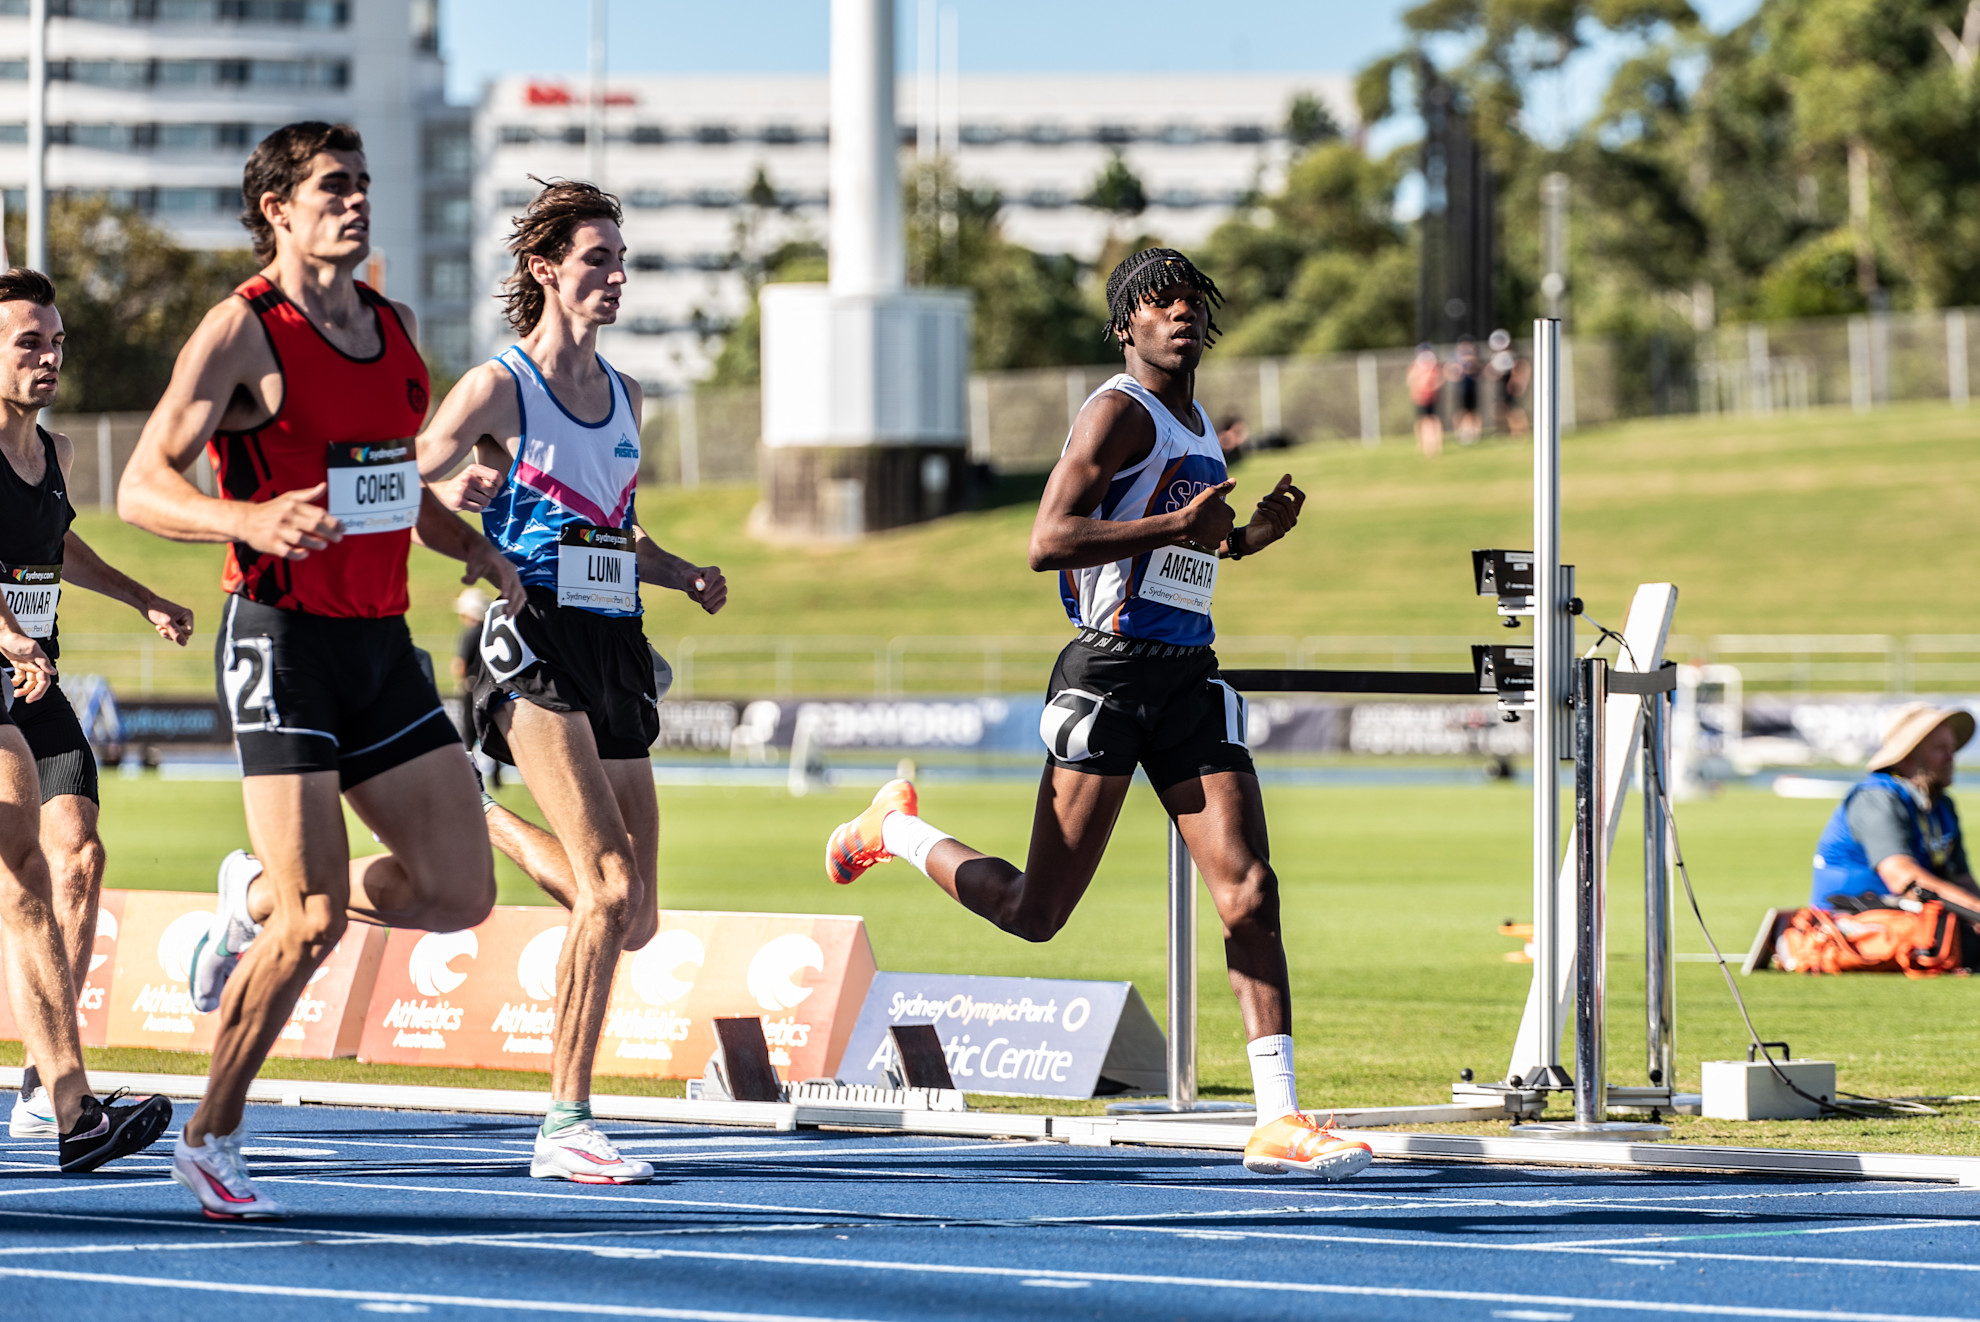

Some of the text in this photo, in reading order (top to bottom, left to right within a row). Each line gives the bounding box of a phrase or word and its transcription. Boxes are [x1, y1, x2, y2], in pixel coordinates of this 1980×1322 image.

[614, 447, 639, 459] RISING
[356, 472, 406, 505] COHEN
[595, 533, 628, 546] sydney.com
[25, 571, 55, 582] sydney.com
[588, 555, 621, 584] LUNN
[1159, 552, 1214, 589] AMEKATA
[6, 590, 51, 615] DONNAR
[485, 603, 523, 674] 5
[229, 645, 265, 723] 2
[1052, 693, 1098, 758] 7
[142, 1013, 195, 1033] Australia
[383, 998, 464, 1031] Athletics
[604, 1007, 691, 1041] Athletics
[392, 1029, 446, 1049] Australia
[762, 1015, 812, 1047] letics
[615, 1039, 673, 1061] Australia
[867, 1034, 1073, 1082] Atic Centre
